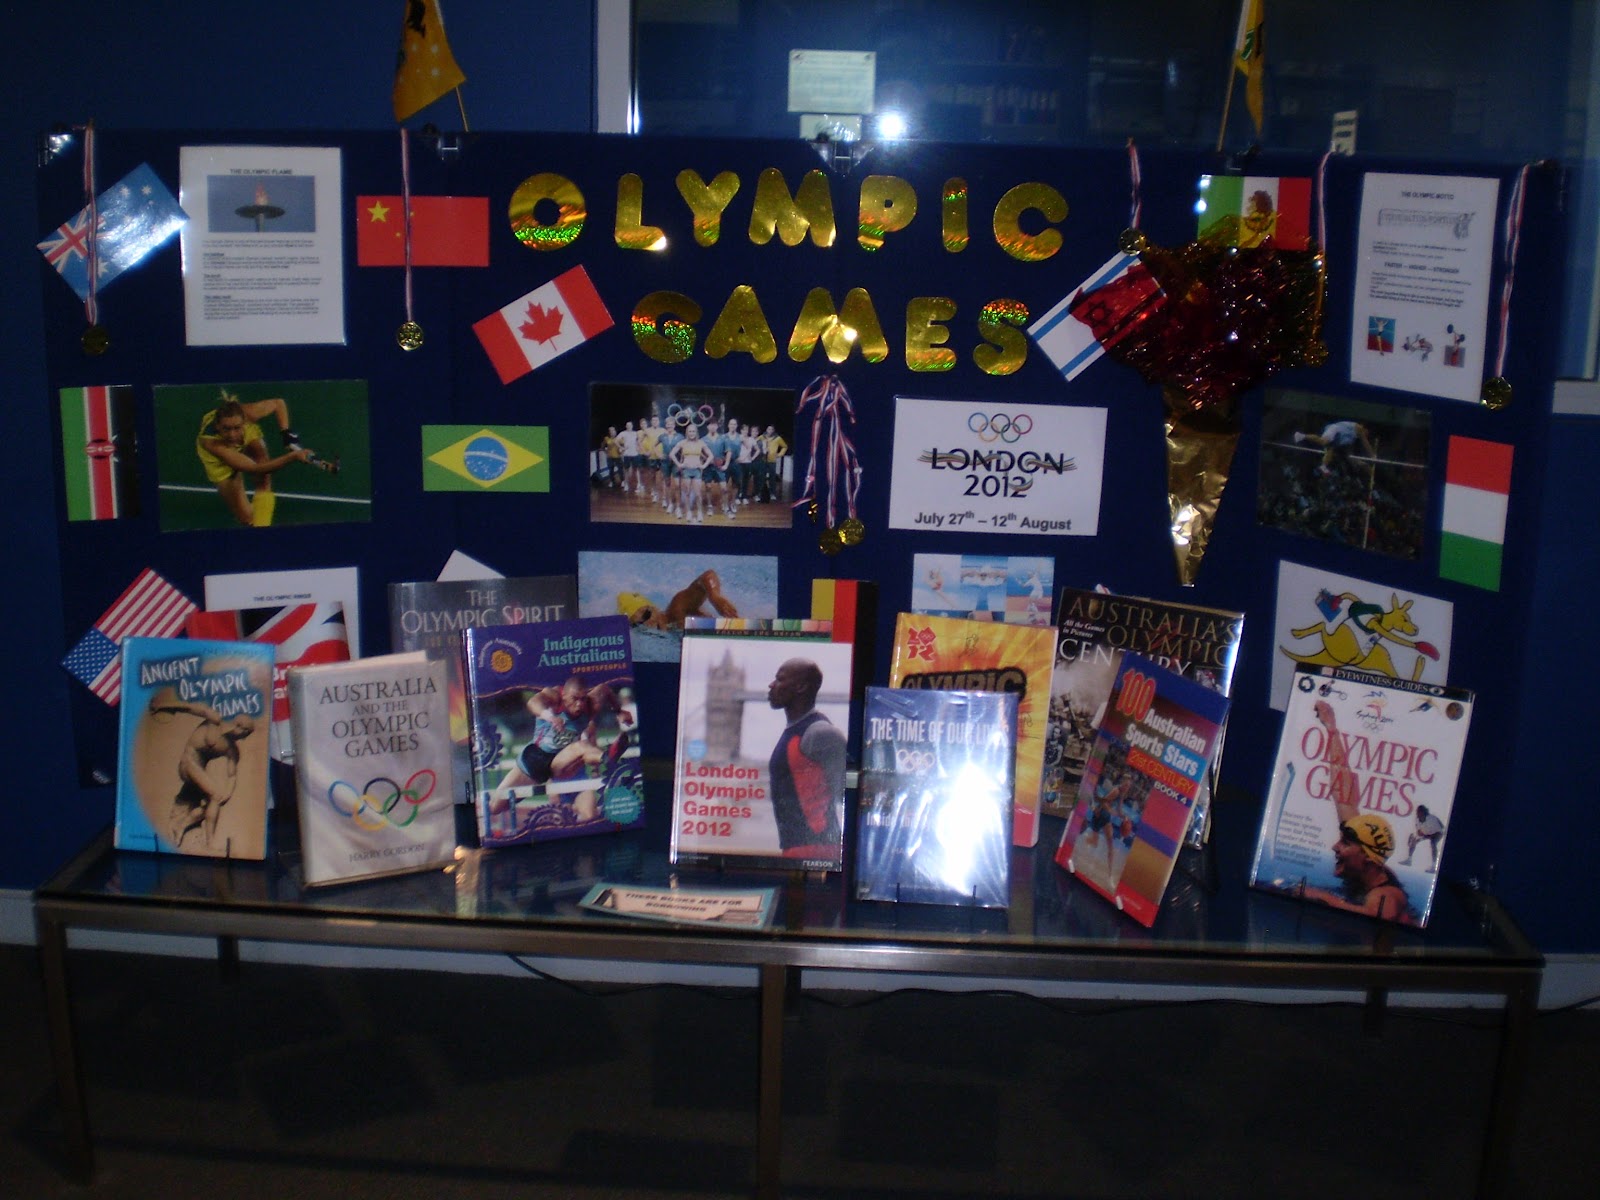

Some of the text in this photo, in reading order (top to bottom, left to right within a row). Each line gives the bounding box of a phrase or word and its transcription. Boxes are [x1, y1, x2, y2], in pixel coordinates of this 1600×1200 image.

[508, 168, 1069, 261] OLYMPIC
[631, 285, 1030, 375] GAMES
[931, 448, 1064, 475] LONDON
[963, 474, 1027, 498] 2012
[914, 511, 945, 528] July
[948, 510, 975, 526] 27th
[991, 512, 1017, 528] 12th
[1020, 516, 1072, 532] August
[466, 590, 499, 607] THE
[401, 604, 565, 634] OLYMPIC SPIRIT
[1068, 597, 1239, 645] AUSTRALIA'S
[1084, 623, 1106, 633] Games
[543, 634, 624, 652] Indigenous
[1070, 628, 1093, 638] Pictures
[1107, 625, 1231, 667] OLYMPIC
[537, 648, 626, 667] Australians
[572, 662, 627, 674] SPORTSPEOPLE
[1059, 638, 1191, 676] CENRY
[141, 656, 199, 686] ANCIENT
[1336, 669, 1429, 693] EYEWITNESS GUIDES
[179, 672, 248, 700] OLYMPIC
[320, 677, 437, 705] AUSTRALIA
[1115, 667, 1156, 722] 100
[212, 693, 261, 717] GAMES
[352, 701, 408, 715] AND THE
[332, 711, 431, 739] OLYMPIC
[870, 717, 893, 741] THE
[896, 718, 926, 742] TIME
[928, 720, 945, 743] OF
[1144, 708, 1207, 754] Australian
[345, 733, 420, 758] GAMES
[1125, 723, 1164, 758] Sports
[1164, 743, 1199, 776] Stars
[1301, 727, 1438, 784] OLYMPIC
[685, 761, 760, 779] London
[1148, 758, 1194, 793] CENTURY
[684, 781, 765, 800] Olympic
[1153, 780, 1188, 806] BOOK 4
[1305, 765, 1416, 816] GAMES
[683, 801, 752, 819] Games
[681, 821, 732, 837] 2012
[802, 859, 834, 869] PEARSON
